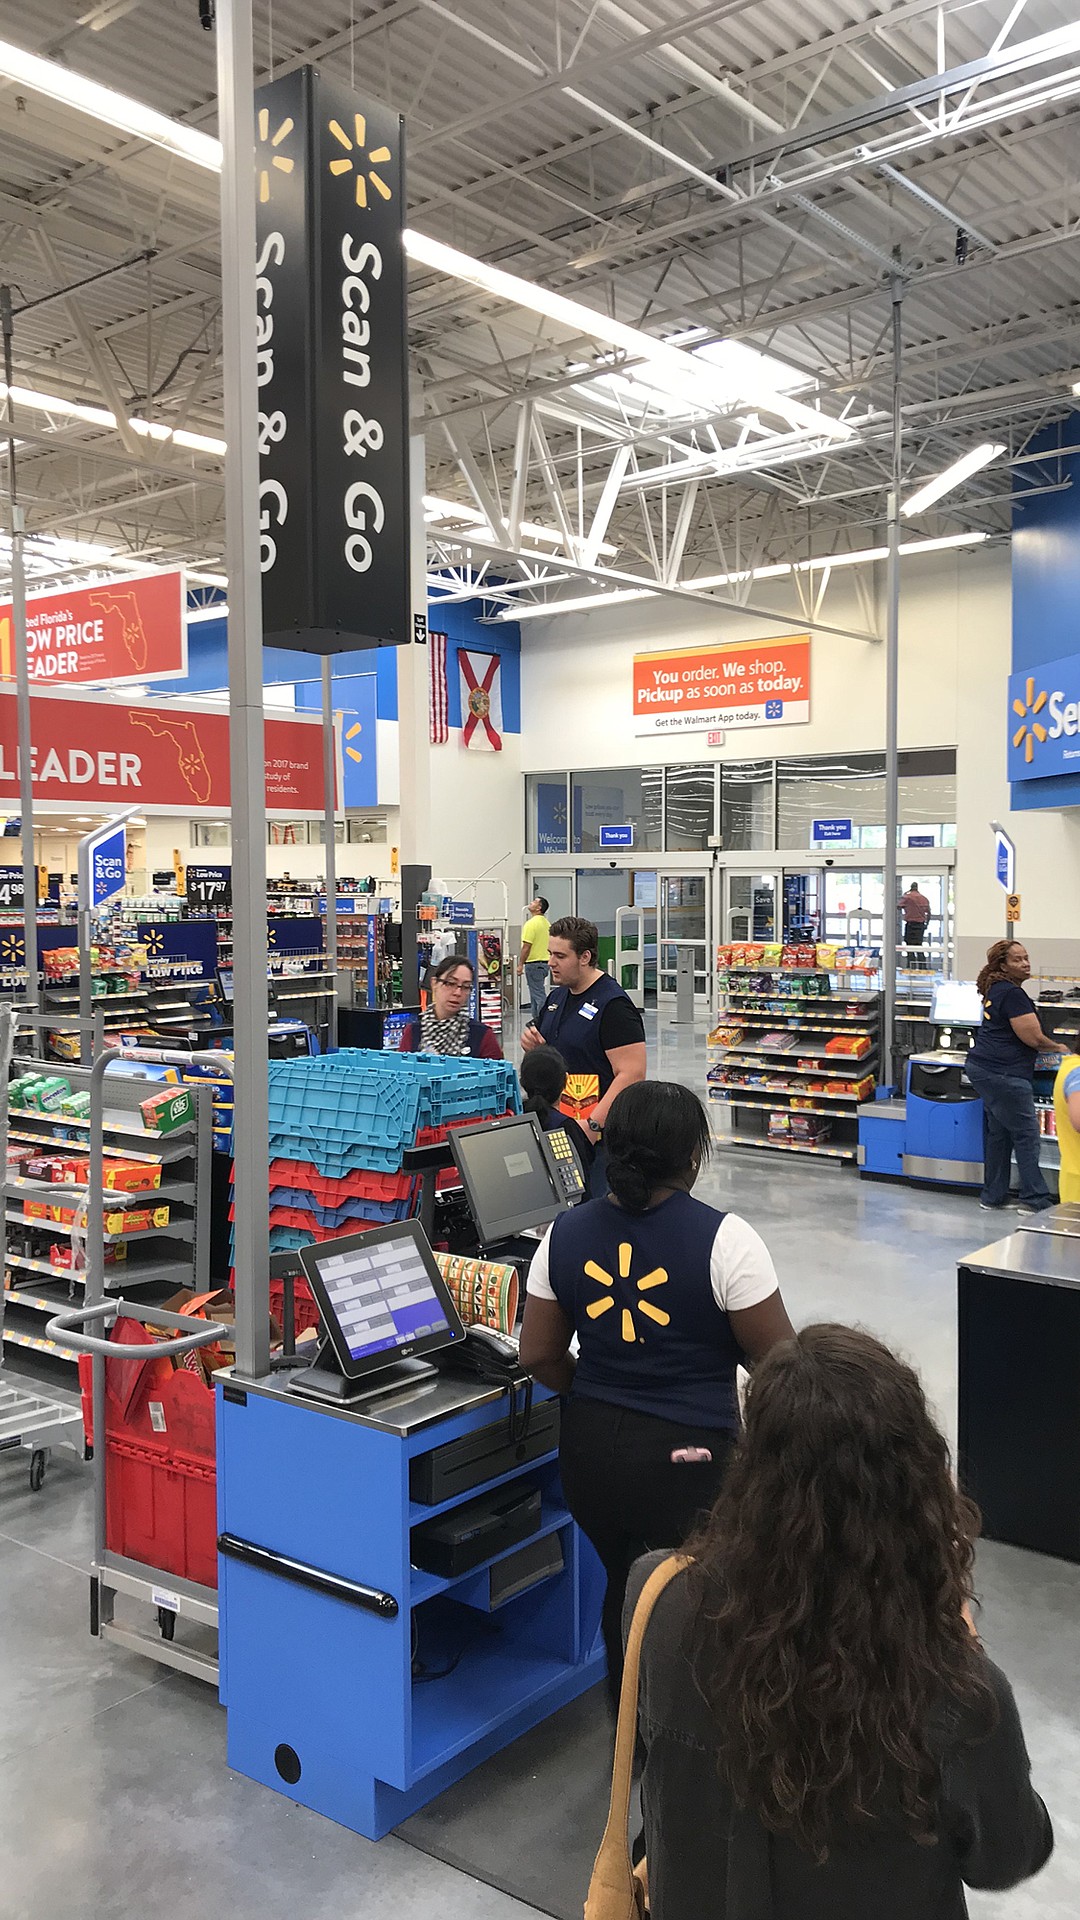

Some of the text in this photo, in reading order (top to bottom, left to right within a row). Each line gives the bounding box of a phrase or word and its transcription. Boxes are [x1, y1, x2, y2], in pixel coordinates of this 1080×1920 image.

[256, 232, 288, 572] Scan & Go
[341, 232, 385, 572] Scan & Go
[26, 609, 73, 627] ted Florida's
[26, 620, 104, 652] OW PRICE
[27, 651, 78, 678] EADER
[653, 659, 786, 684] You order. We shop.
[637, 675, 804, 704] Pickup as soon as today.
[655, 711, 761, 727] Get the Walmart App today.
[1049, 691, 1080, 738] Se
[708, 732, 721, 744] EXIT
[273, 759, 288, 768] 2017
[289, 761, 309, 769] brand
[283, 773, 291, 781] of
[266, 785, 299, 794] residents.
[836, 824, 847, 832] you
[539, 833, 568, 844] Welcom
[95, 855, 122, 867] Scan
[95, 867, 122, 878] &Go
[1007, 910, 1019, 920] 30
